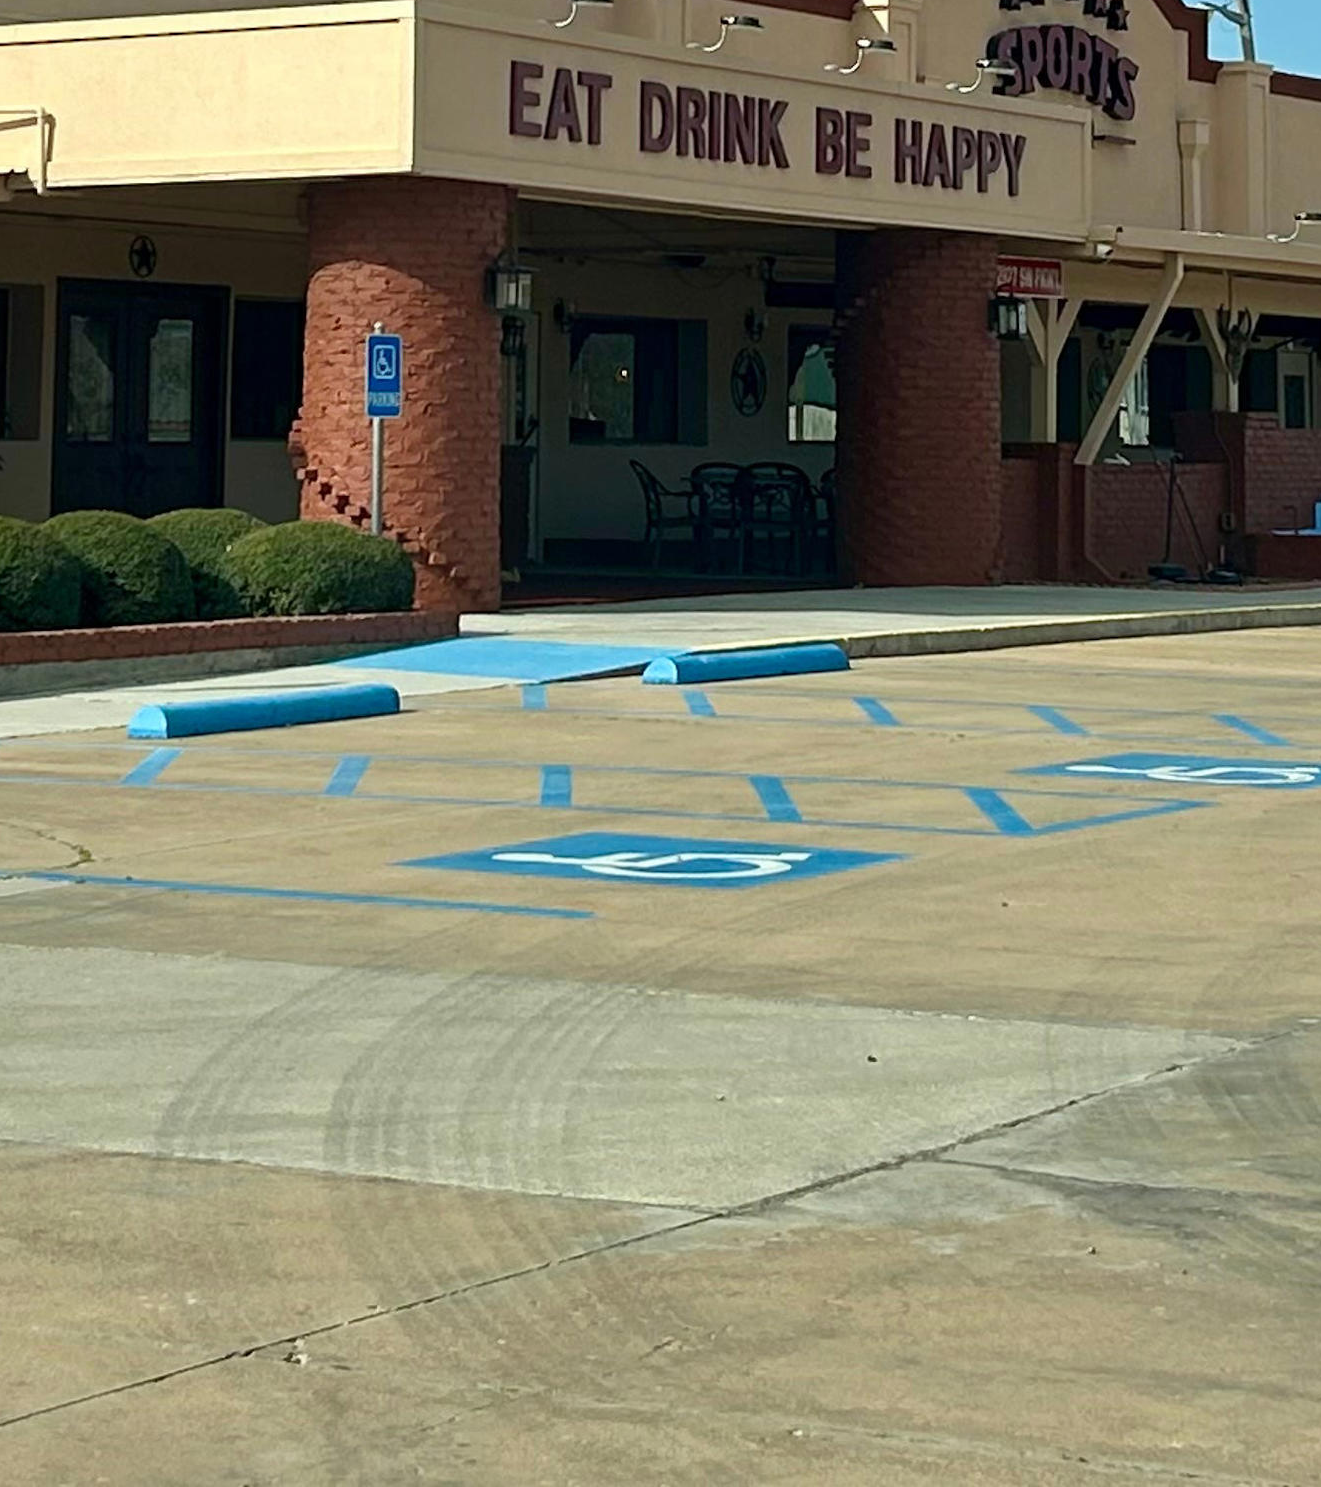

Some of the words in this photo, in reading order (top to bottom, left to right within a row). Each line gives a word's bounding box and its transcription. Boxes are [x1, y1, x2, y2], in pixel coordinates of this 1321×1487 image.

[509, 59, 613, 146] EAT
[639, 79, 790, 169] DRINK
[815, 106, 873, 180] BE
[894, 118, 1027, 197] HAPPY
[986, 24, 1139, 121] SPORTS
